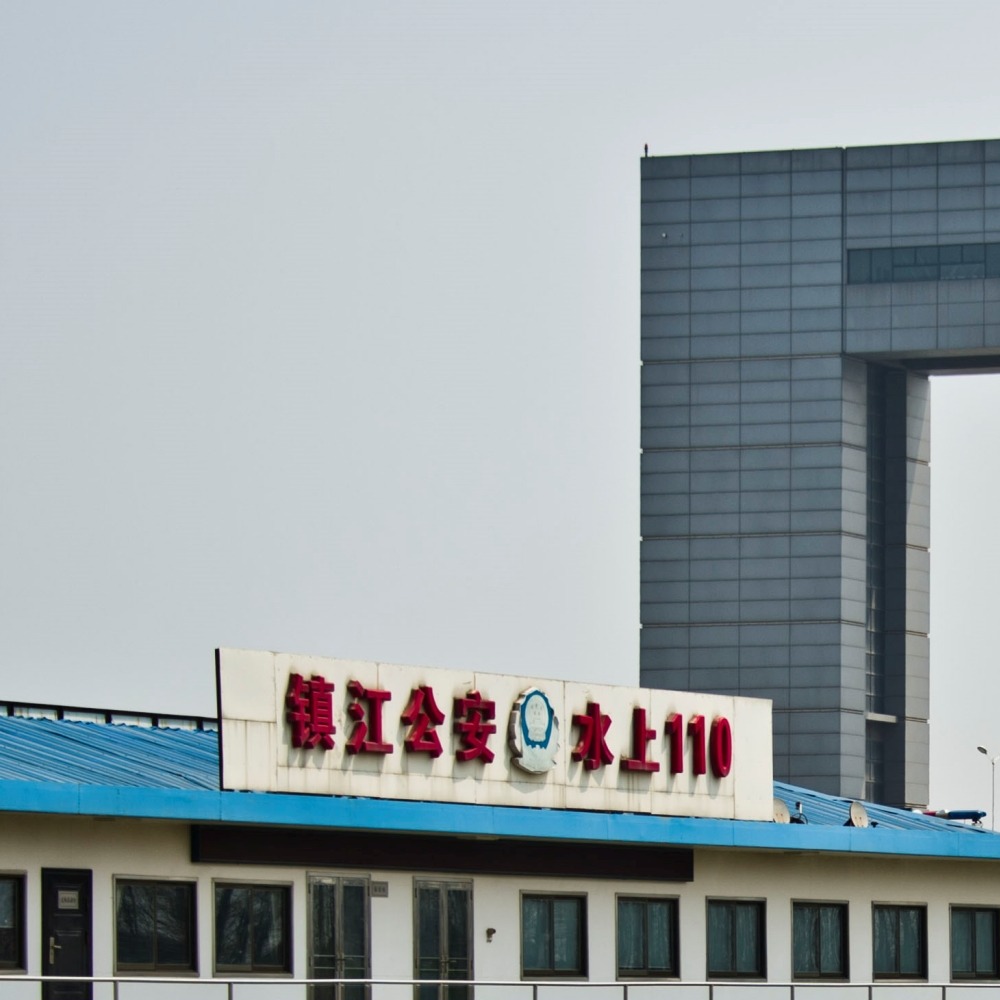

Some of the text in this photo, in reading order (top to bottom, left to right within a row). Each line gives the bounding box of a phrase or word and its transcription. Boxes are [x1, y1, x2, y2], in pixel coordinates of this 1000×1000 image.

[286, 673, 733, 778] 镇江公安 水上110
